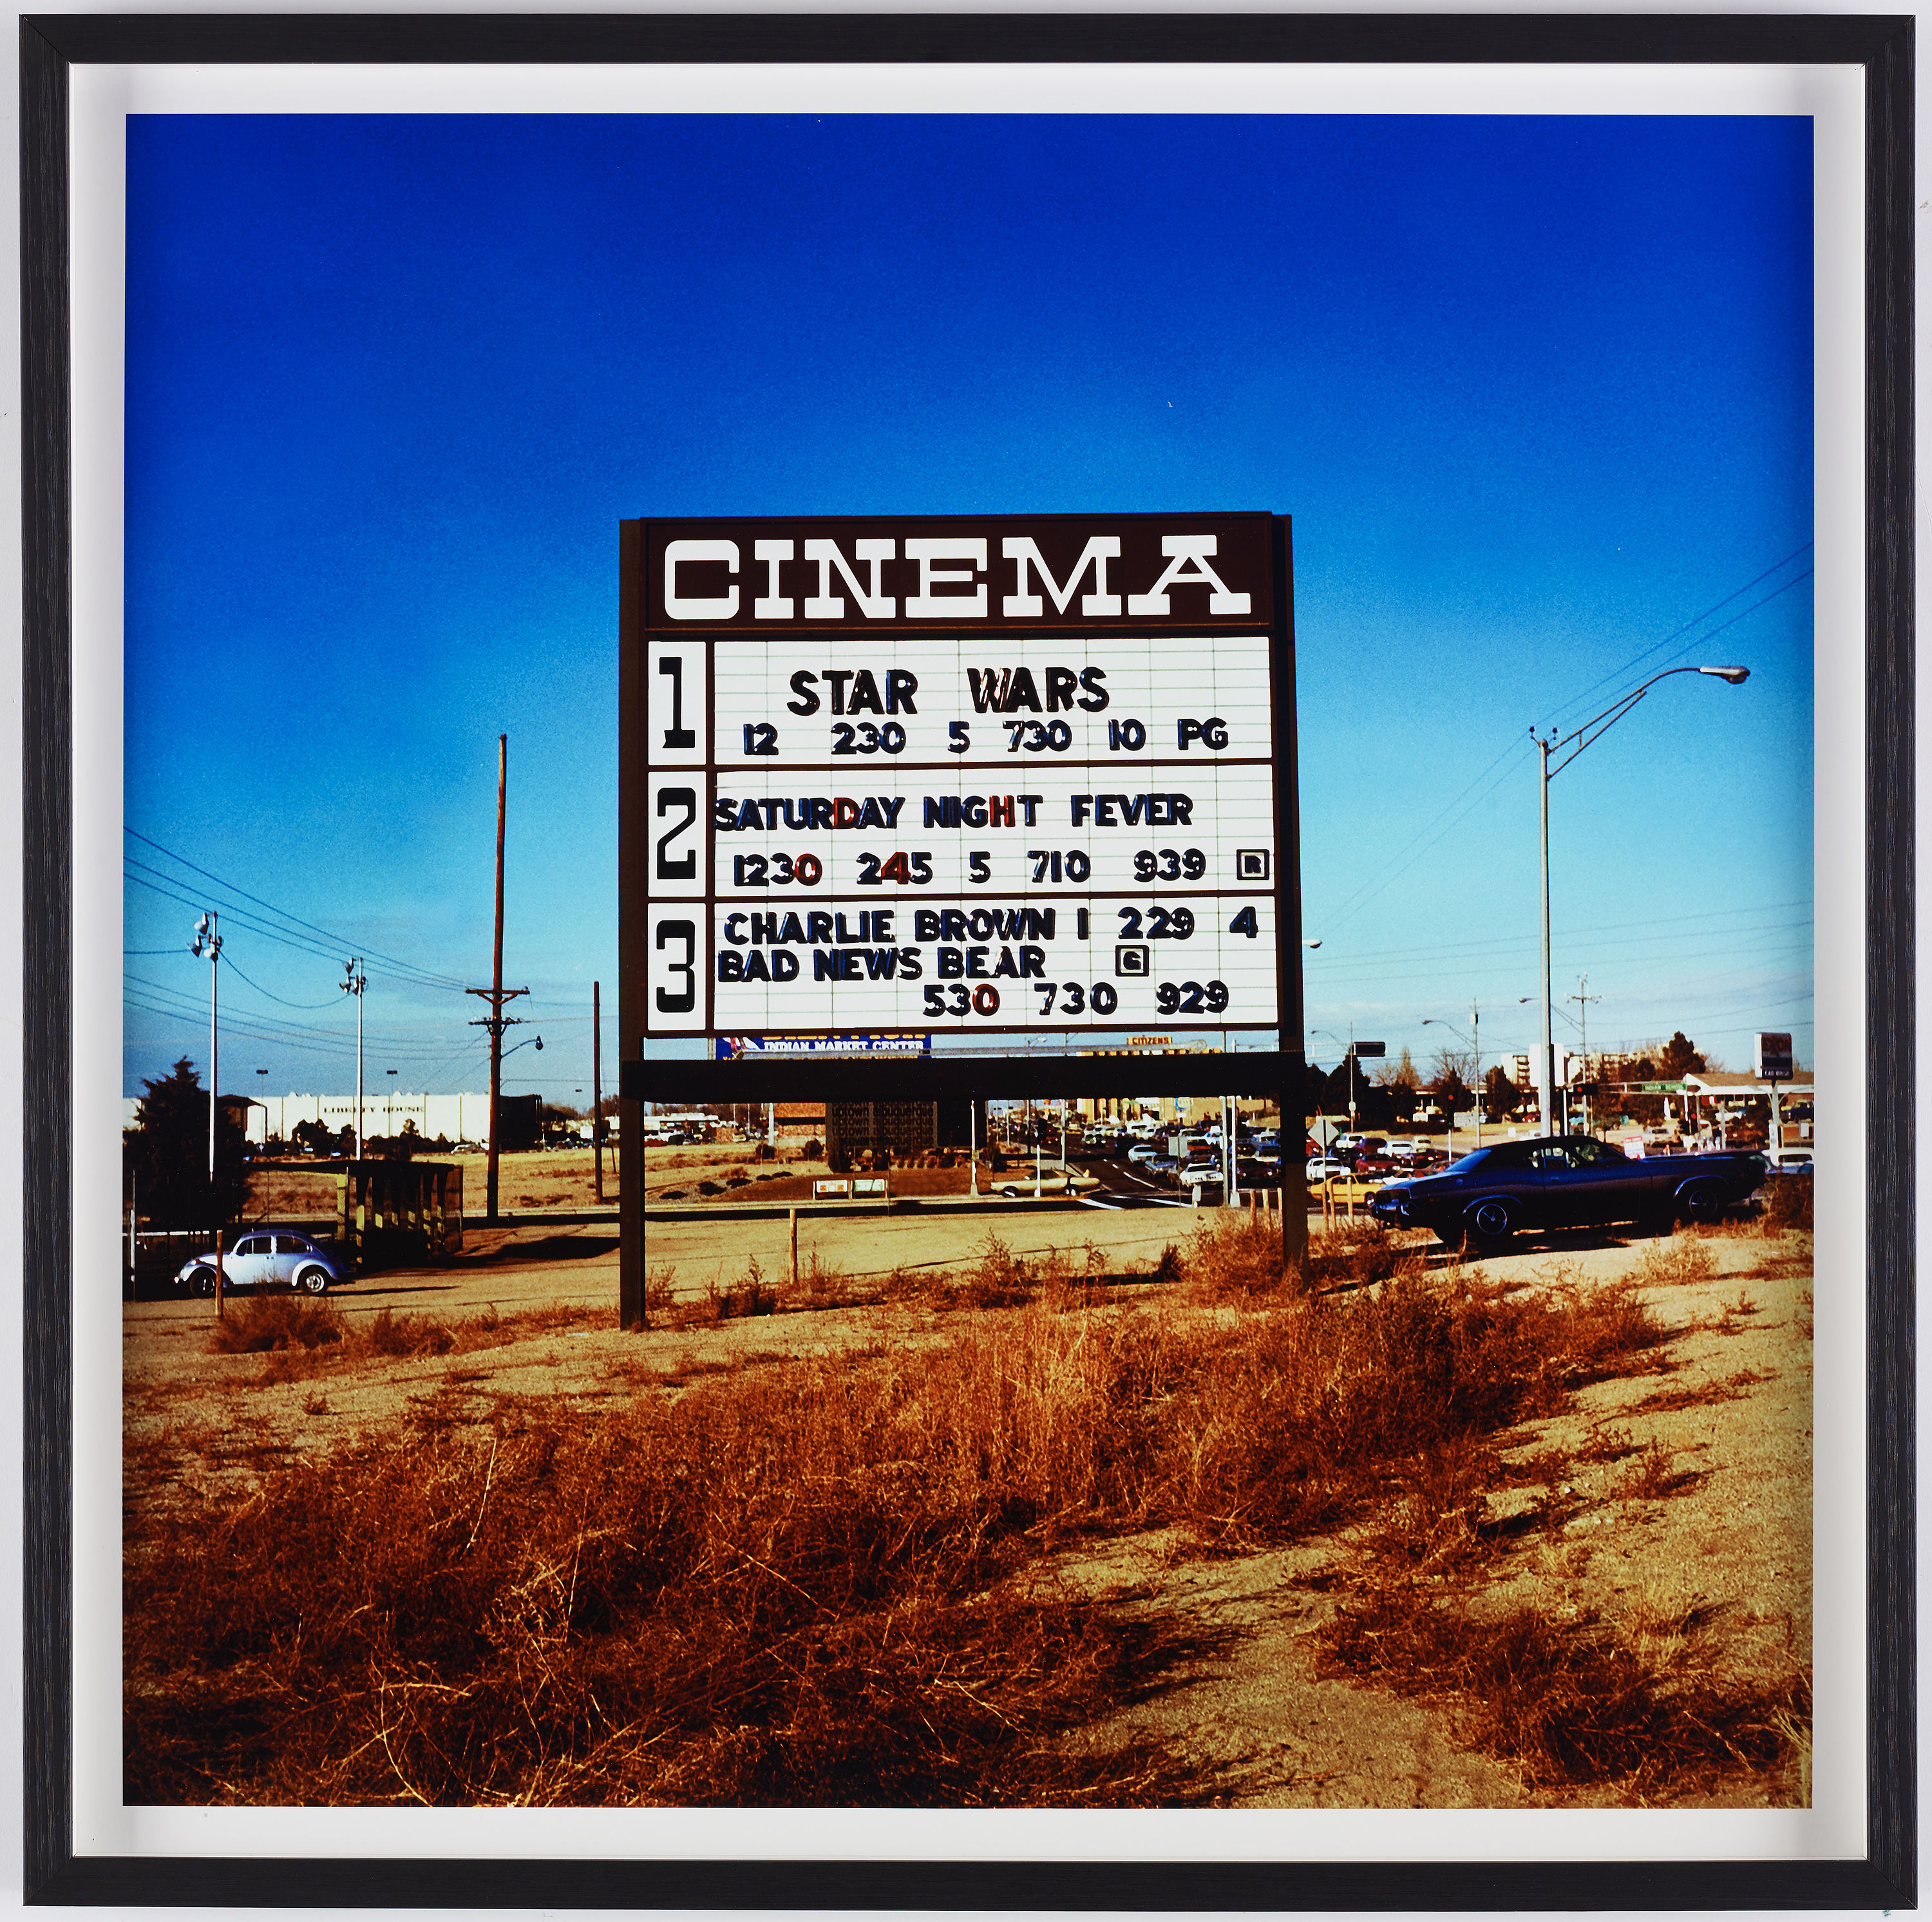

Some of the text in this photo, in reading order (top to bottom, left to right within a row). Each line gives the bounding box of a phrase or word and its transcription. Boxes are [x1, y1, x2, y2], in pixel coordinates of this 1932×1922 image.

[664, 535, 1252, 620] CINEMA
[659, 656, 696, 748] 1
[786, 666, 1110, 717] STAR WARS
[743, 717, 1229, 756] 12 230 5 730 10 PG
[715, 792, 1193, 831] SATURDAY NIGHT FEVER
[656, 787, 696, 880] 2
[734, 852, 823, 887] 1230
[855, 851, 933, 885] 245
[968, 851, 991, 884] 5
[1027, 850, 1091, 883] 710
[1133, 848, 1206, 882] 939
[724, 909, 896, 945] CHARLIE
[914, 908, 1056, 942] BROWN
[1117, 905, 1195, 940] 229
[1229, 906, 1259, 938] 4
[656, 919, 696, 1013] 3
[718, 949, 800, 983] BAD
[813, 947, 923, 982] NEWS
[937, 944, 1046, 979] BEAR
[922, 980, 1229, 1018] 530 730 929
[763, 1040, 923, 1050] INDIAN MARKET CENTER
[1132, 1036, 1169, 1045] CITIZENS
